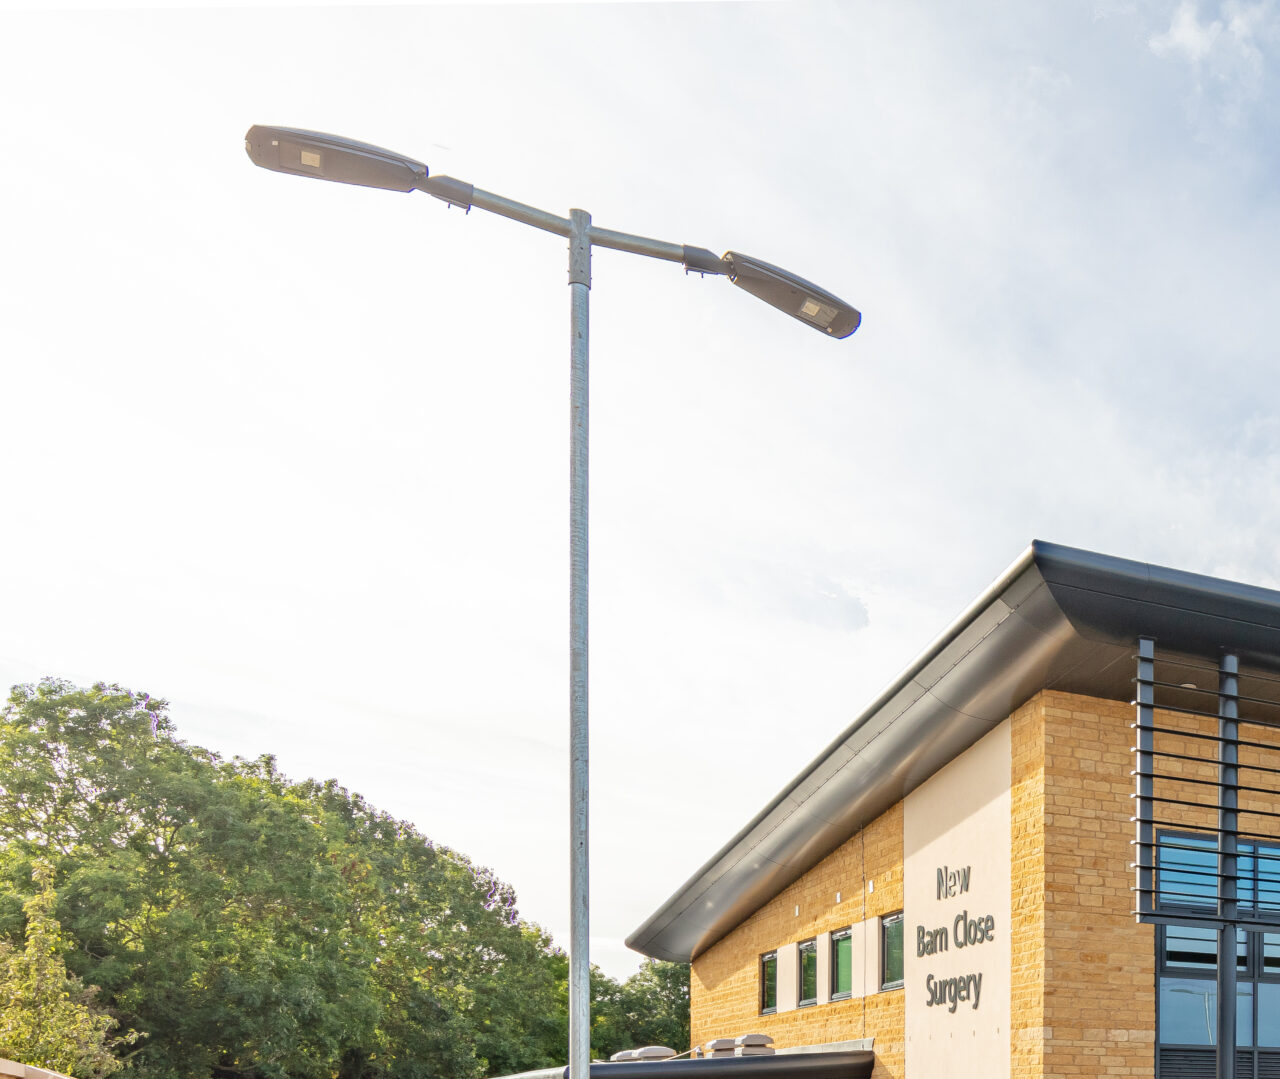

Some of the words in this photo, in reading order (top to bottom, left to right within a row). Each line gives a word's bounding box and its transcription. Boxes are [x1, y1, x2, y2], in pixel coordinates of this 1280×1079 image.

[937, 865, 971, 900] New
[917, 925, 948, 957] Barn
[953, 910, 994, 948] Close
[926, 972, 982, 1014] Surgery
